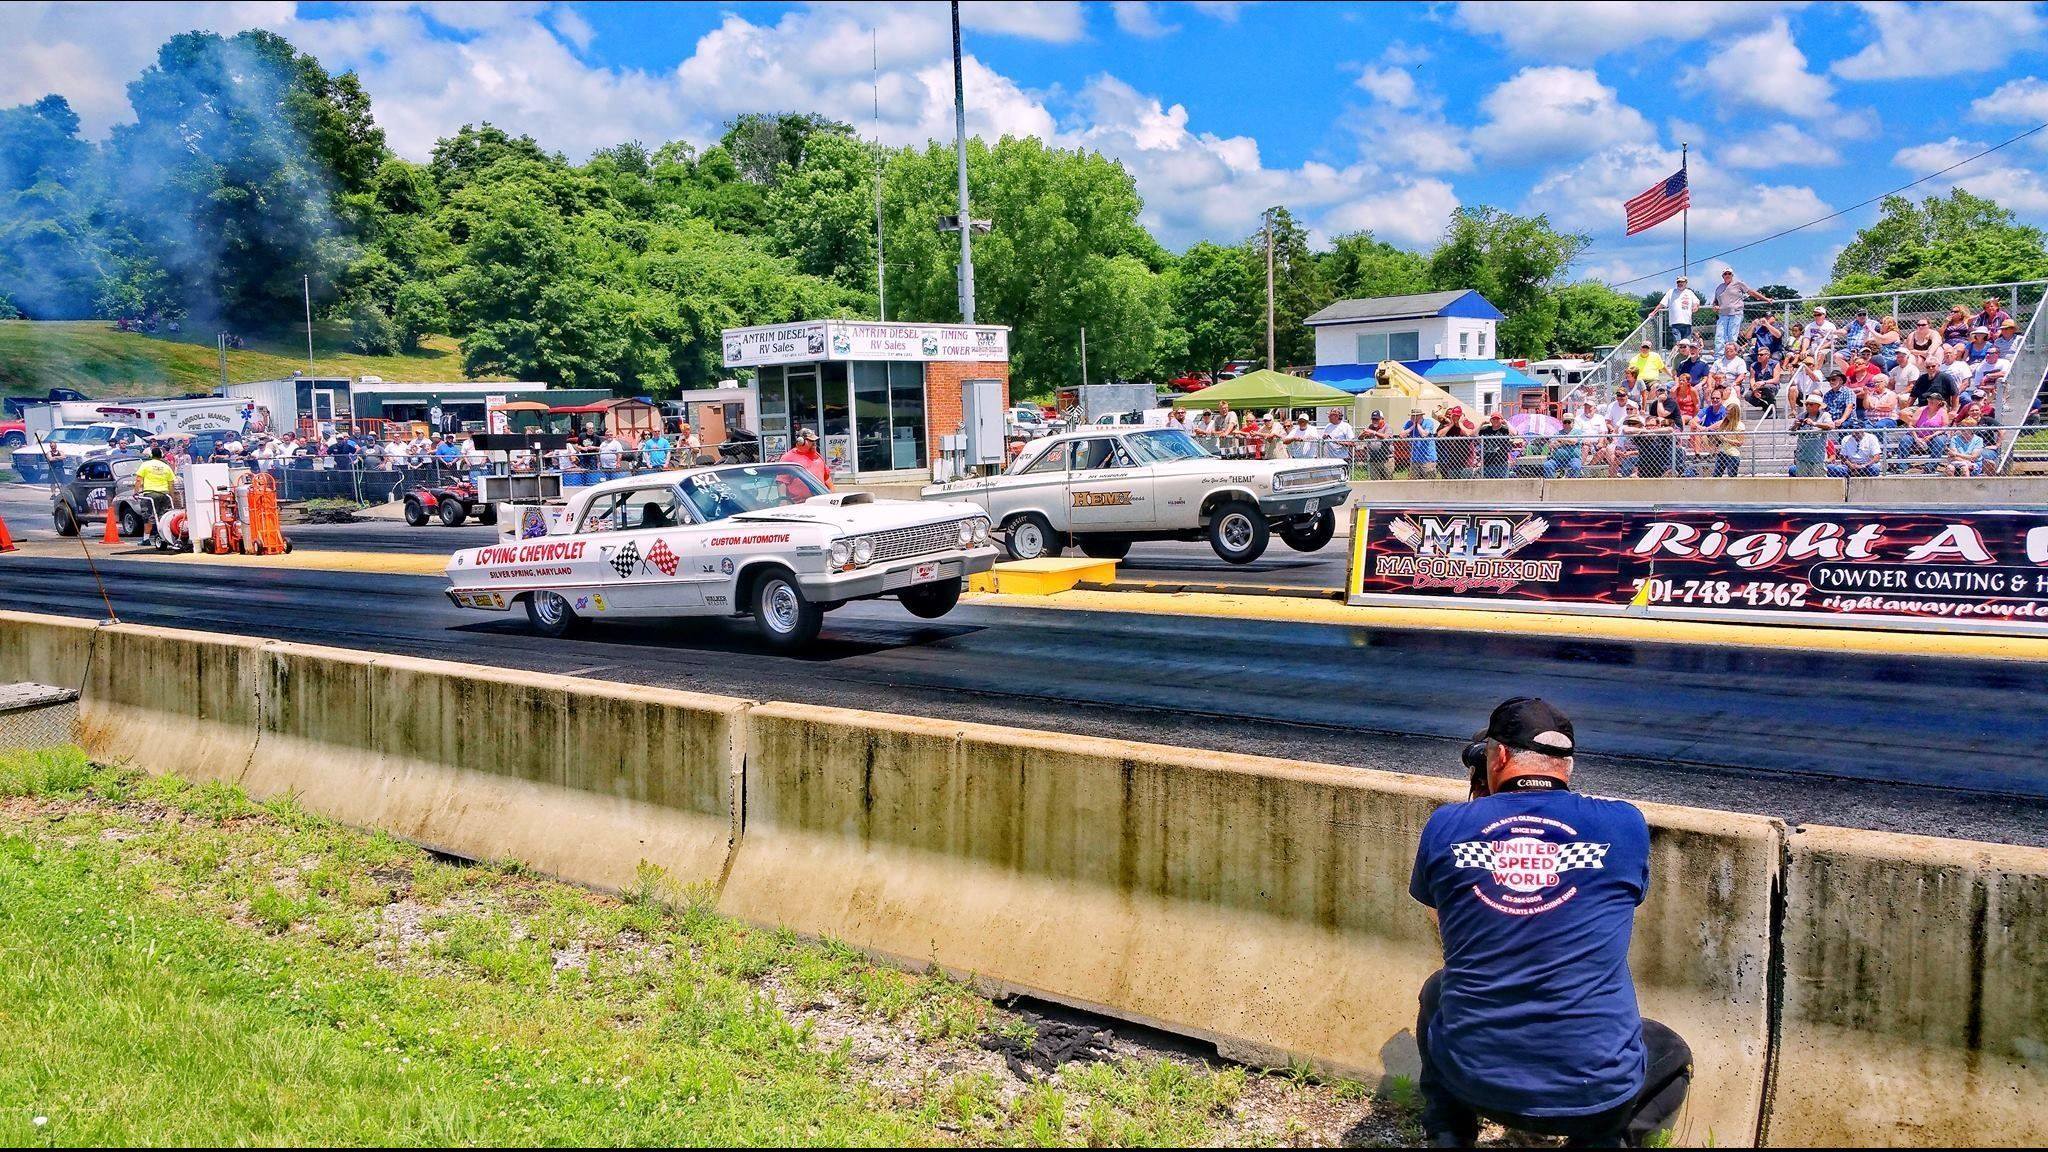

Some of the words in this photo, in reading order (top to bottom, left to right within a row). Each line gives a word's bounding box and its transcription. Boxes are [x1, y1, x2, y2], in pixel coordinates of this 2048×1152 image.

[742, 331, 775, 344] ANTRIM
[778, 328, 808, 341] DIESEL
[852, 327, 887, 338] ANTRIM
[890, 328, 919, 339] DIESEL
[941, 330, 968, 340] TIMING
[759, 344, 770, 354] RV
[772, 342, 795, 353] Sales
[870, 340, 882, 350] RV
[884, 340, 906, 350] Sales
[942, 346, 970, 356] TOWER
[178, 414, 206, 428] CARROLL
[208, 412, 231, 424] MANOR
[1072, 491, 1132, 508] HEMI
[710, 536, 741, 547] CUSTOM
[742, 534, 790, 544] AUTOMOTIVE
[1633, 521, 1887, 571] Right
[476, 548, 516, 566] LOVING
[519, 542, 586, 564] CHEVROLET
[489, 570, 511, 578] SILVER
[511, 568, 536, 578] SPRING,
[536, 567, 572, 576] MARYLAND
[1375, 556, 1562, 582] MASON-DIXON
[1412, 574, 1519, 594] Dragway
[1820, 568, 1908, 588] POWDER
[1914, 570, 2005, 592] COATING
[2010, 574, 2028, 592] &
[1631, 578, 1808, 607] 301-748-4362
[1517, 778, 1552, 788] Canon
[1492, 840, 1559, 856] UNITED
[1498, 856, 1554, 870] SPEED
[1492, 871, 1560, 887] WORLD
[1472, 885, 1508, 912] PERFORMANCE
[1534, 897, 1564, 913] MACHINE
[1562, 886, 1578, 901] SHOP
